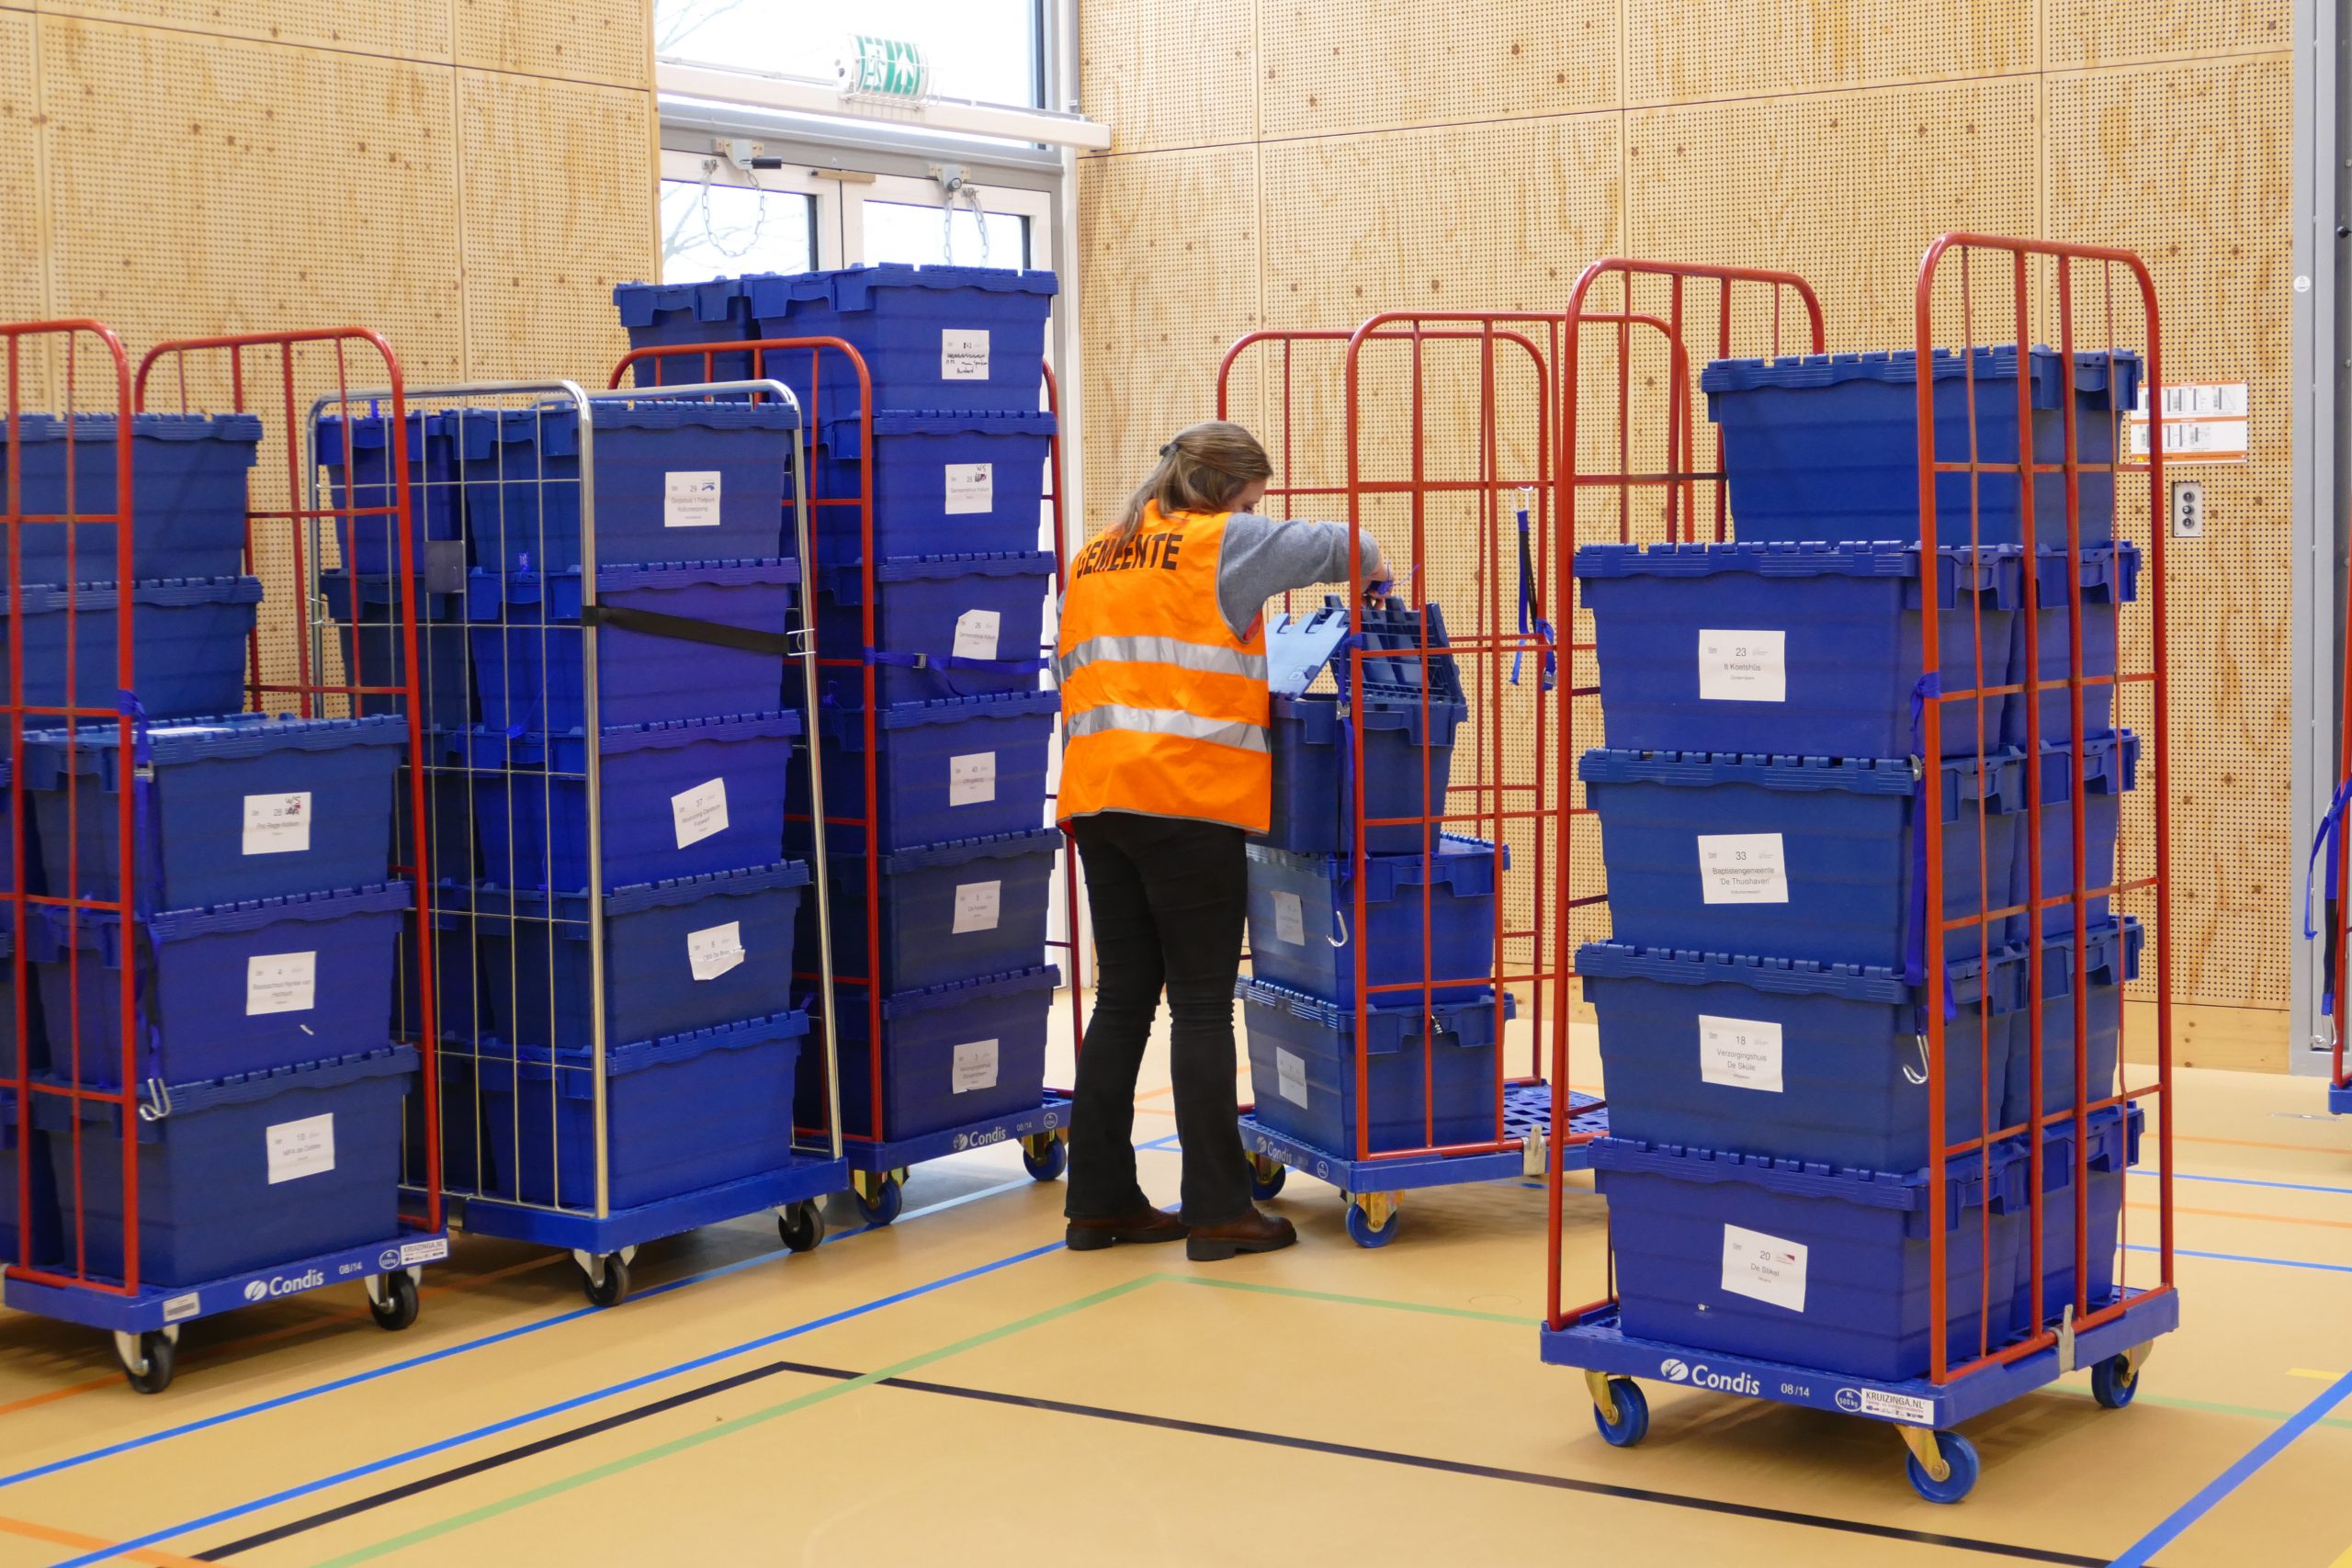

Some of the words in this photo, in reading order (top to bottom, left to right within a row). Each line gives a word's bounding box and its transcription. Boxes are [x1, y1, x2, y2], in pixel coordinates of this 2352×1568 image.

[1736, 647, 1747, 657] 23
[695, 797, 703, 807] 37
[1736, 851, 1747, 861] 33
[1712, 866, 1775, 876] Baptistengemeente
[1736, 1035, 1747, 1045] 18
[1716, 1048, 1768, 1064] Verzorgingshuis
[1727, 1060, 1738, 1068] De
[969, 1126, 1007, 1146] Condis
[1267, 1141, 1292, 1164] Condis
[1759, 1250, 1770, 1261] 20
[1750, 1262, 1761, 1271] De
[1761, 1264, 1780, 1277] Stikel
[269, 1269, 324, 1296] Condis
[338, 1261, 363, 1275] 08/14
[1691, 1364, 1760, 1395] Condis
[1865, 1391, 1924, 1409] KRUIZINGA.NL
